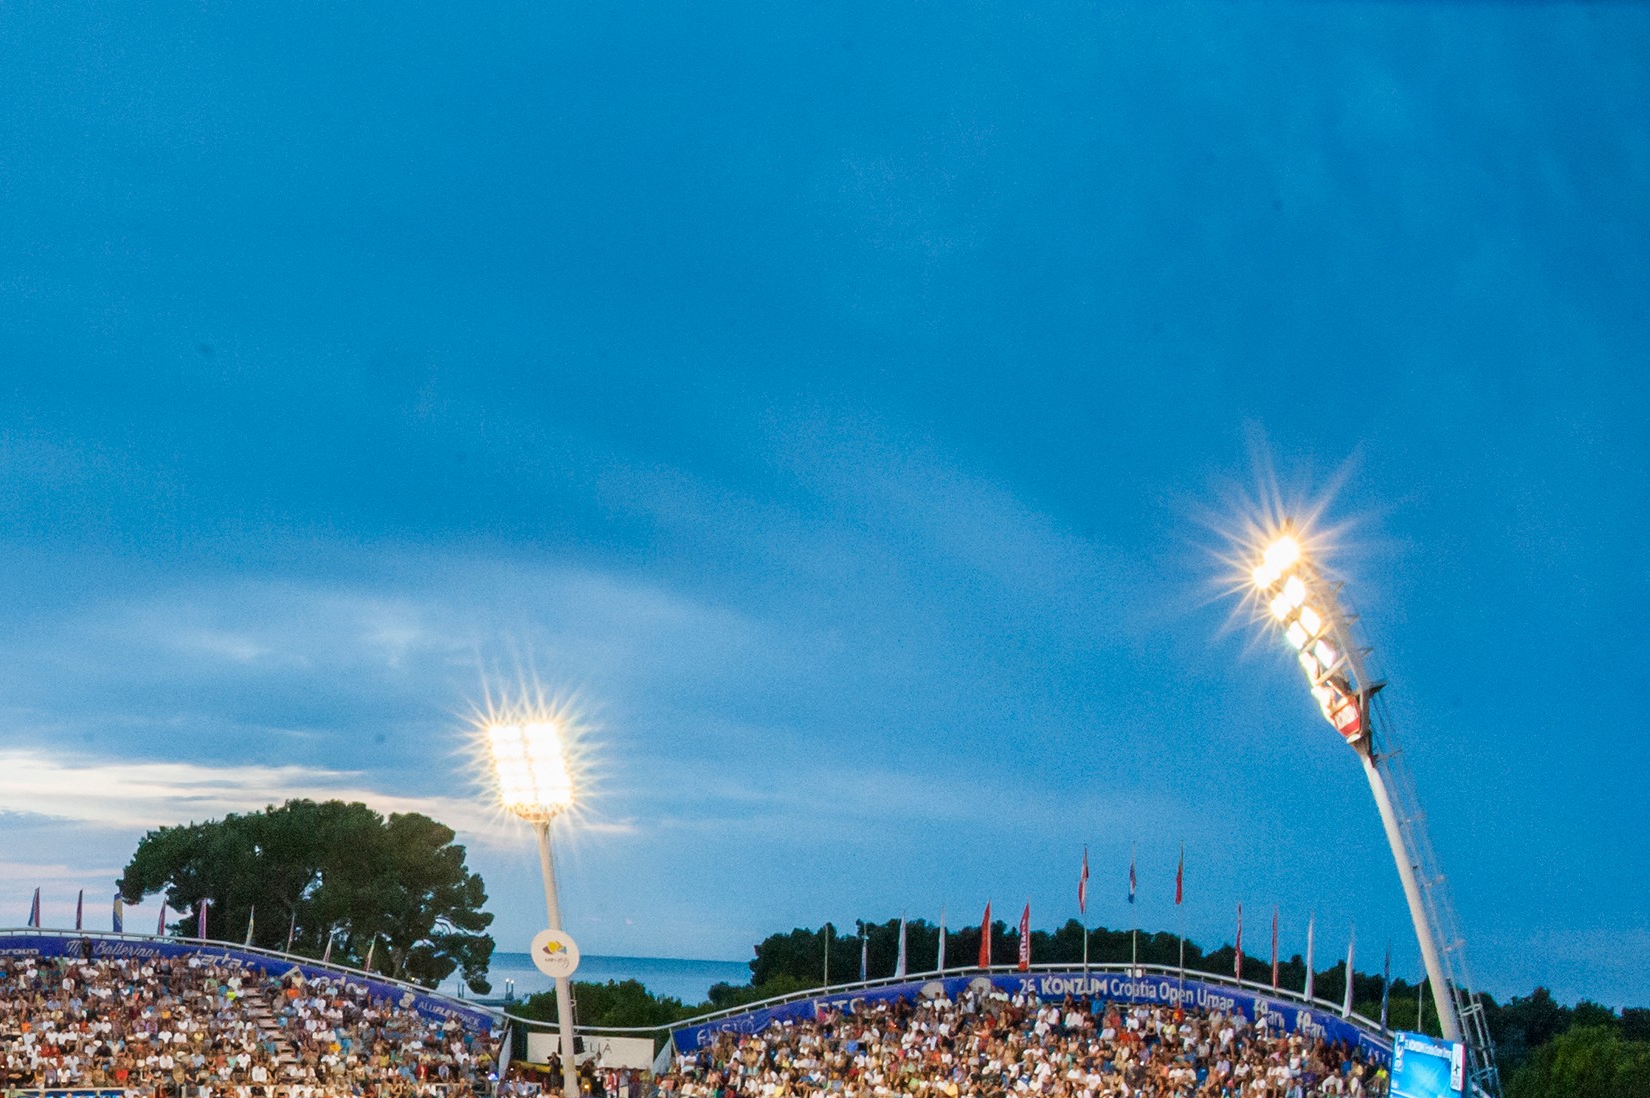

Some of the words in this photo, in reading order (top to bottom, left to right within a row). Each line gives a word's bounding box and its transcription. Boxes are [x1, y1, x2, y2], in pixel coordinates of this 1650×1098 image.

[1041, 975, 1108, 996] KONZUM
[1111, 978, 1157, 999] Croatia
[1159, 981, 1194, 1004] Open
